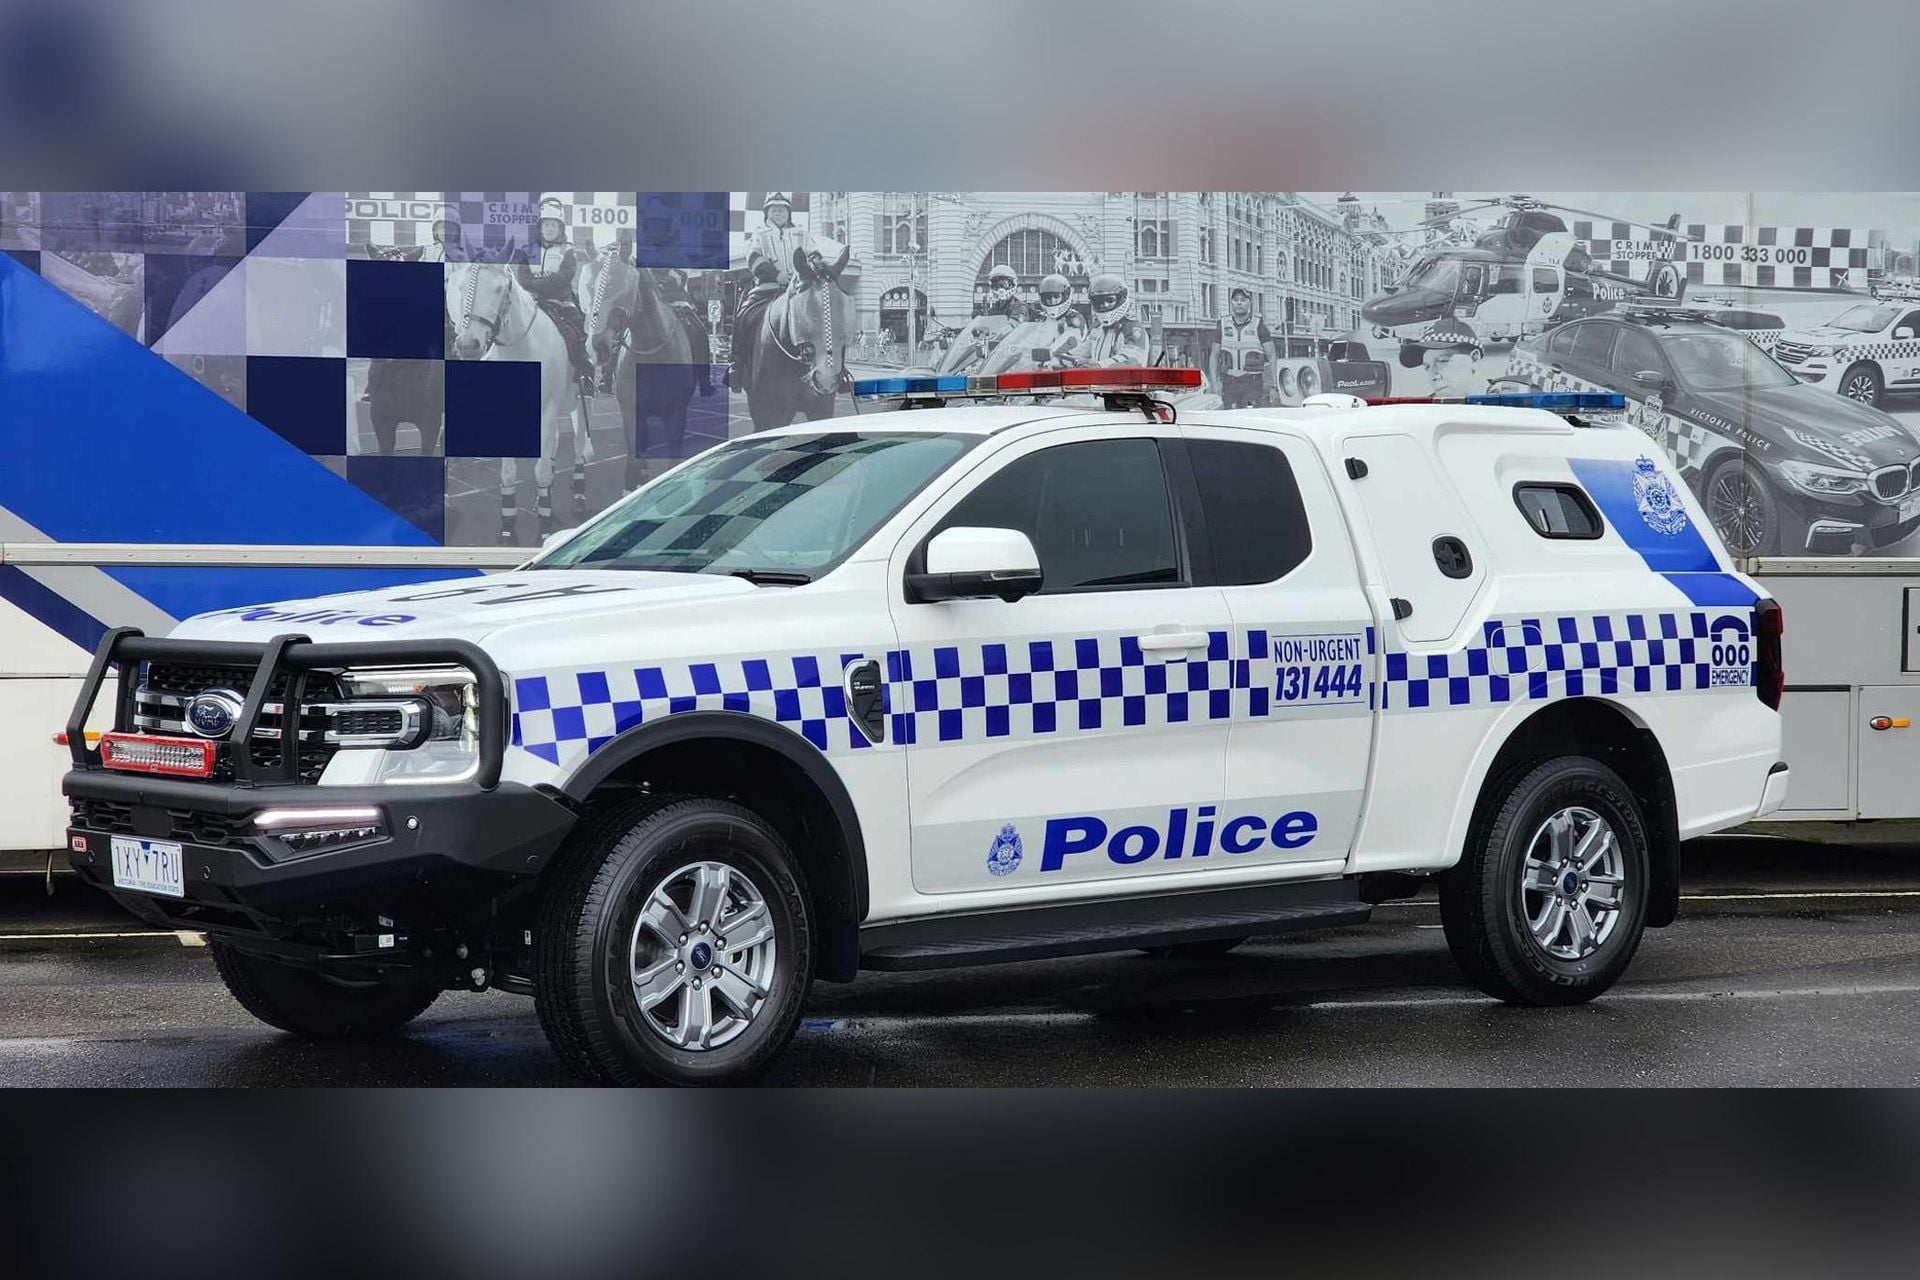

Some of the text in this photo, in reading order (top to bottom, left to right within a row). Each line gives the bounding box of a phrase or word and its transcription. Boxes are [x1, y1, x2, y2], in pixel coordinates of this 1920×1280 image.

[345, 201, 447, 219] POLIC
[579, 208, 629, 224] 1800
[1692, 245, 1734, 260] 1800
[1775, 249, 1807, 264] 000
[1592, 282, 1625, 300] Police
[1689, 407, 1771, 451] VICTORIA POLICE
[1274, 638, 1360, 663] NON-URGENT
[1711, 644, 1750, 667] 000
[1275, 664, 1362, 701] 131 444
[1711, 669, 1749, 685] EMERGENCY
[1040, 805, 1318, 872] Police
